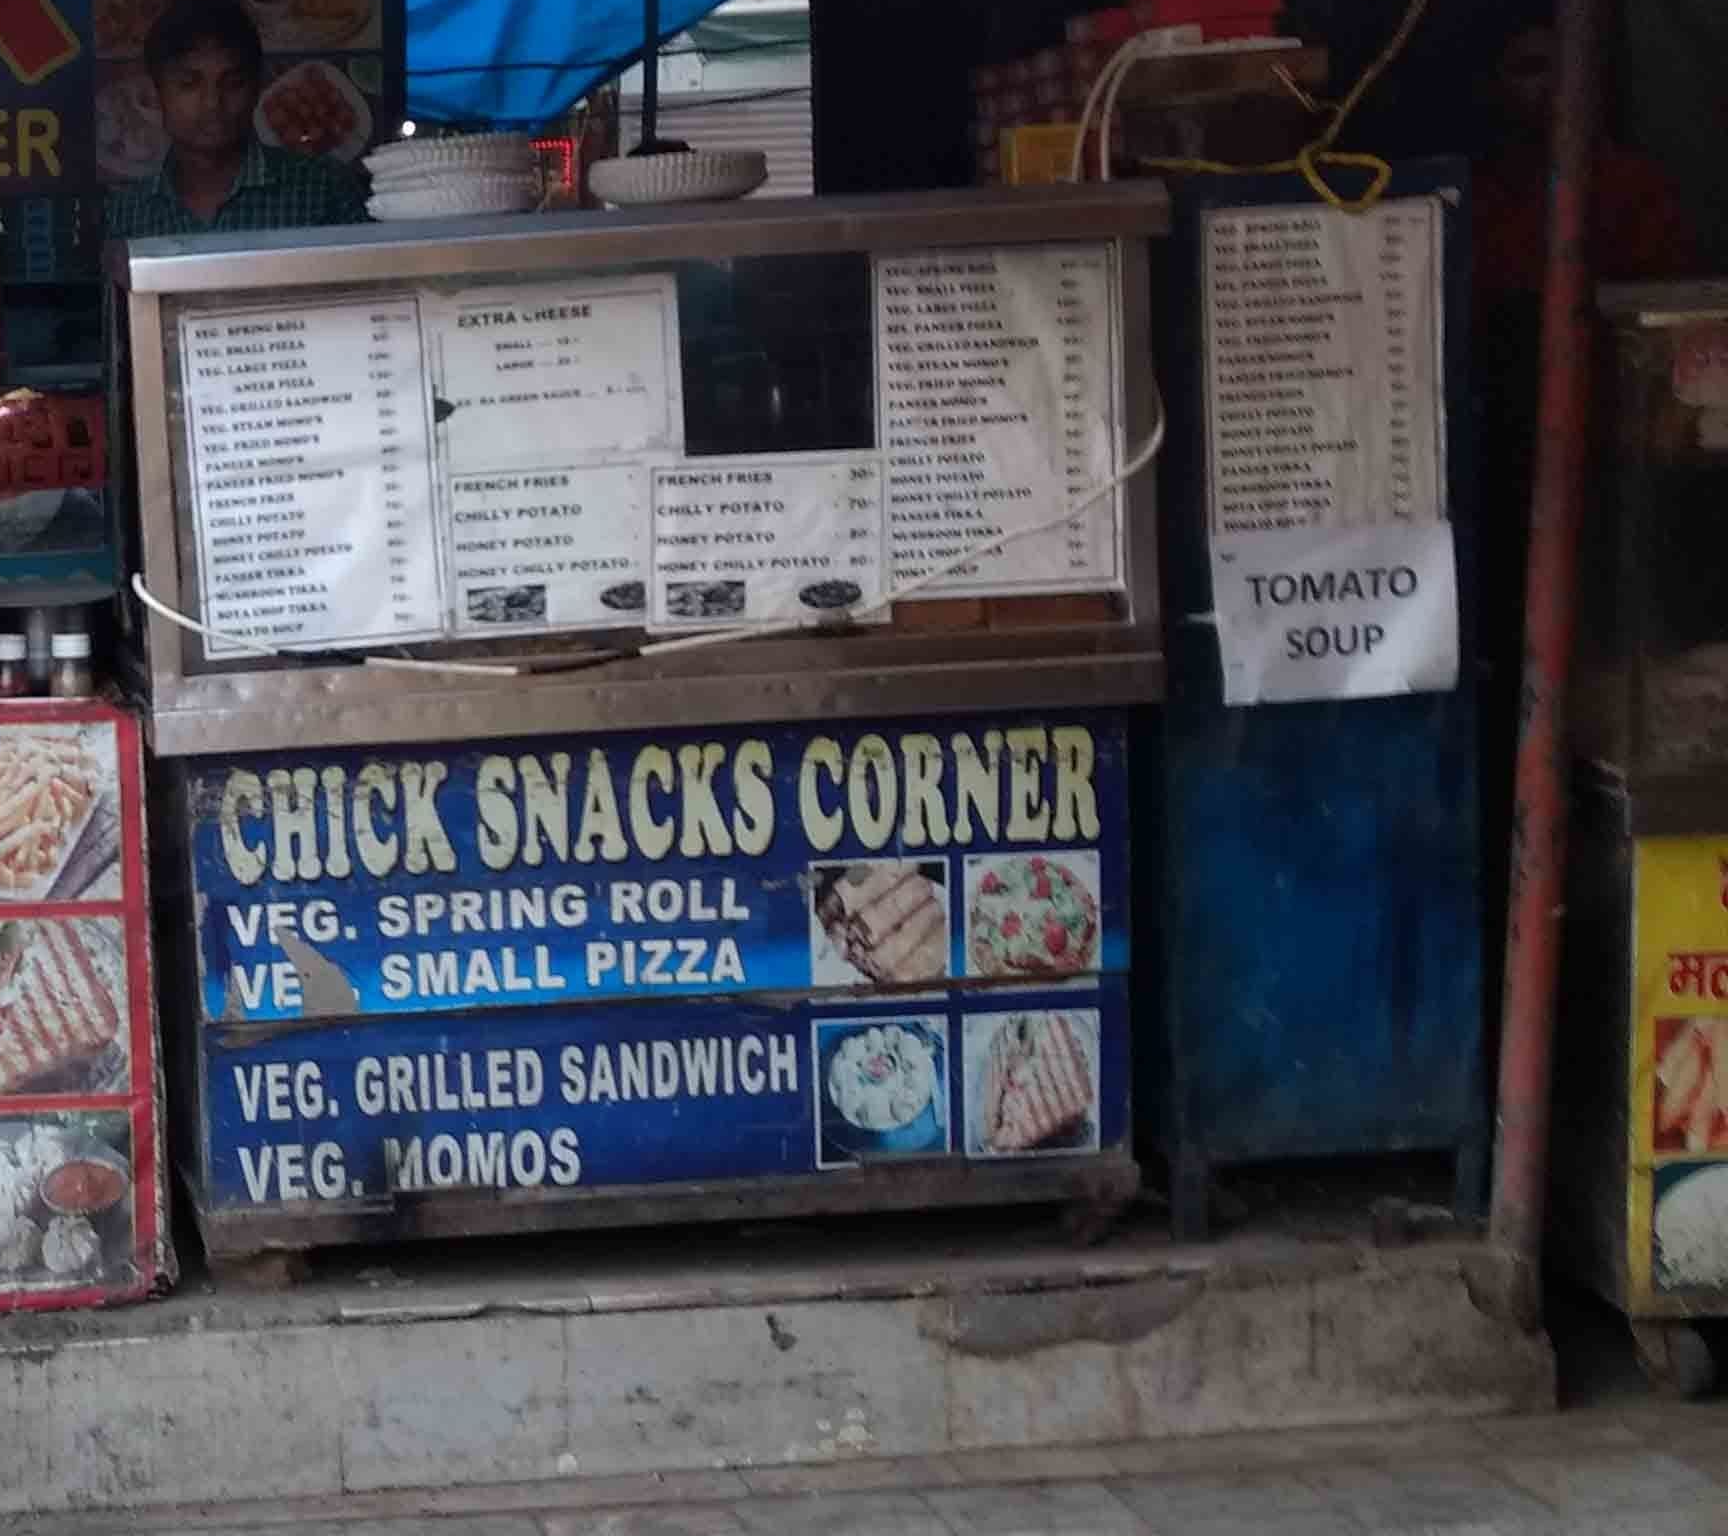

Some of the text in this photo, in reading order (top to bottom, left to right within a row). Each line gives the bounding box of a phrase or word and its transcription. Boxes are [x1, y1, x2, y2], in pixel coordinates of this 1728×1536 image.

[1246, 566, 1418, 606] TOMATO
[1286, 624, 1385, 660] SOUP
[218, 725, 1101, 886] CHICK SNACKS CORNER
[227, 879, 749, 947] VEG. SPRING ROLL
[232, 937, 746, 1010] VE. SMALL PIZZA
[232, 1034, 800, 1123] VEG. GRILLED SANDWICH
[237, 1130, 580, 1202] VEG. MOMOS
